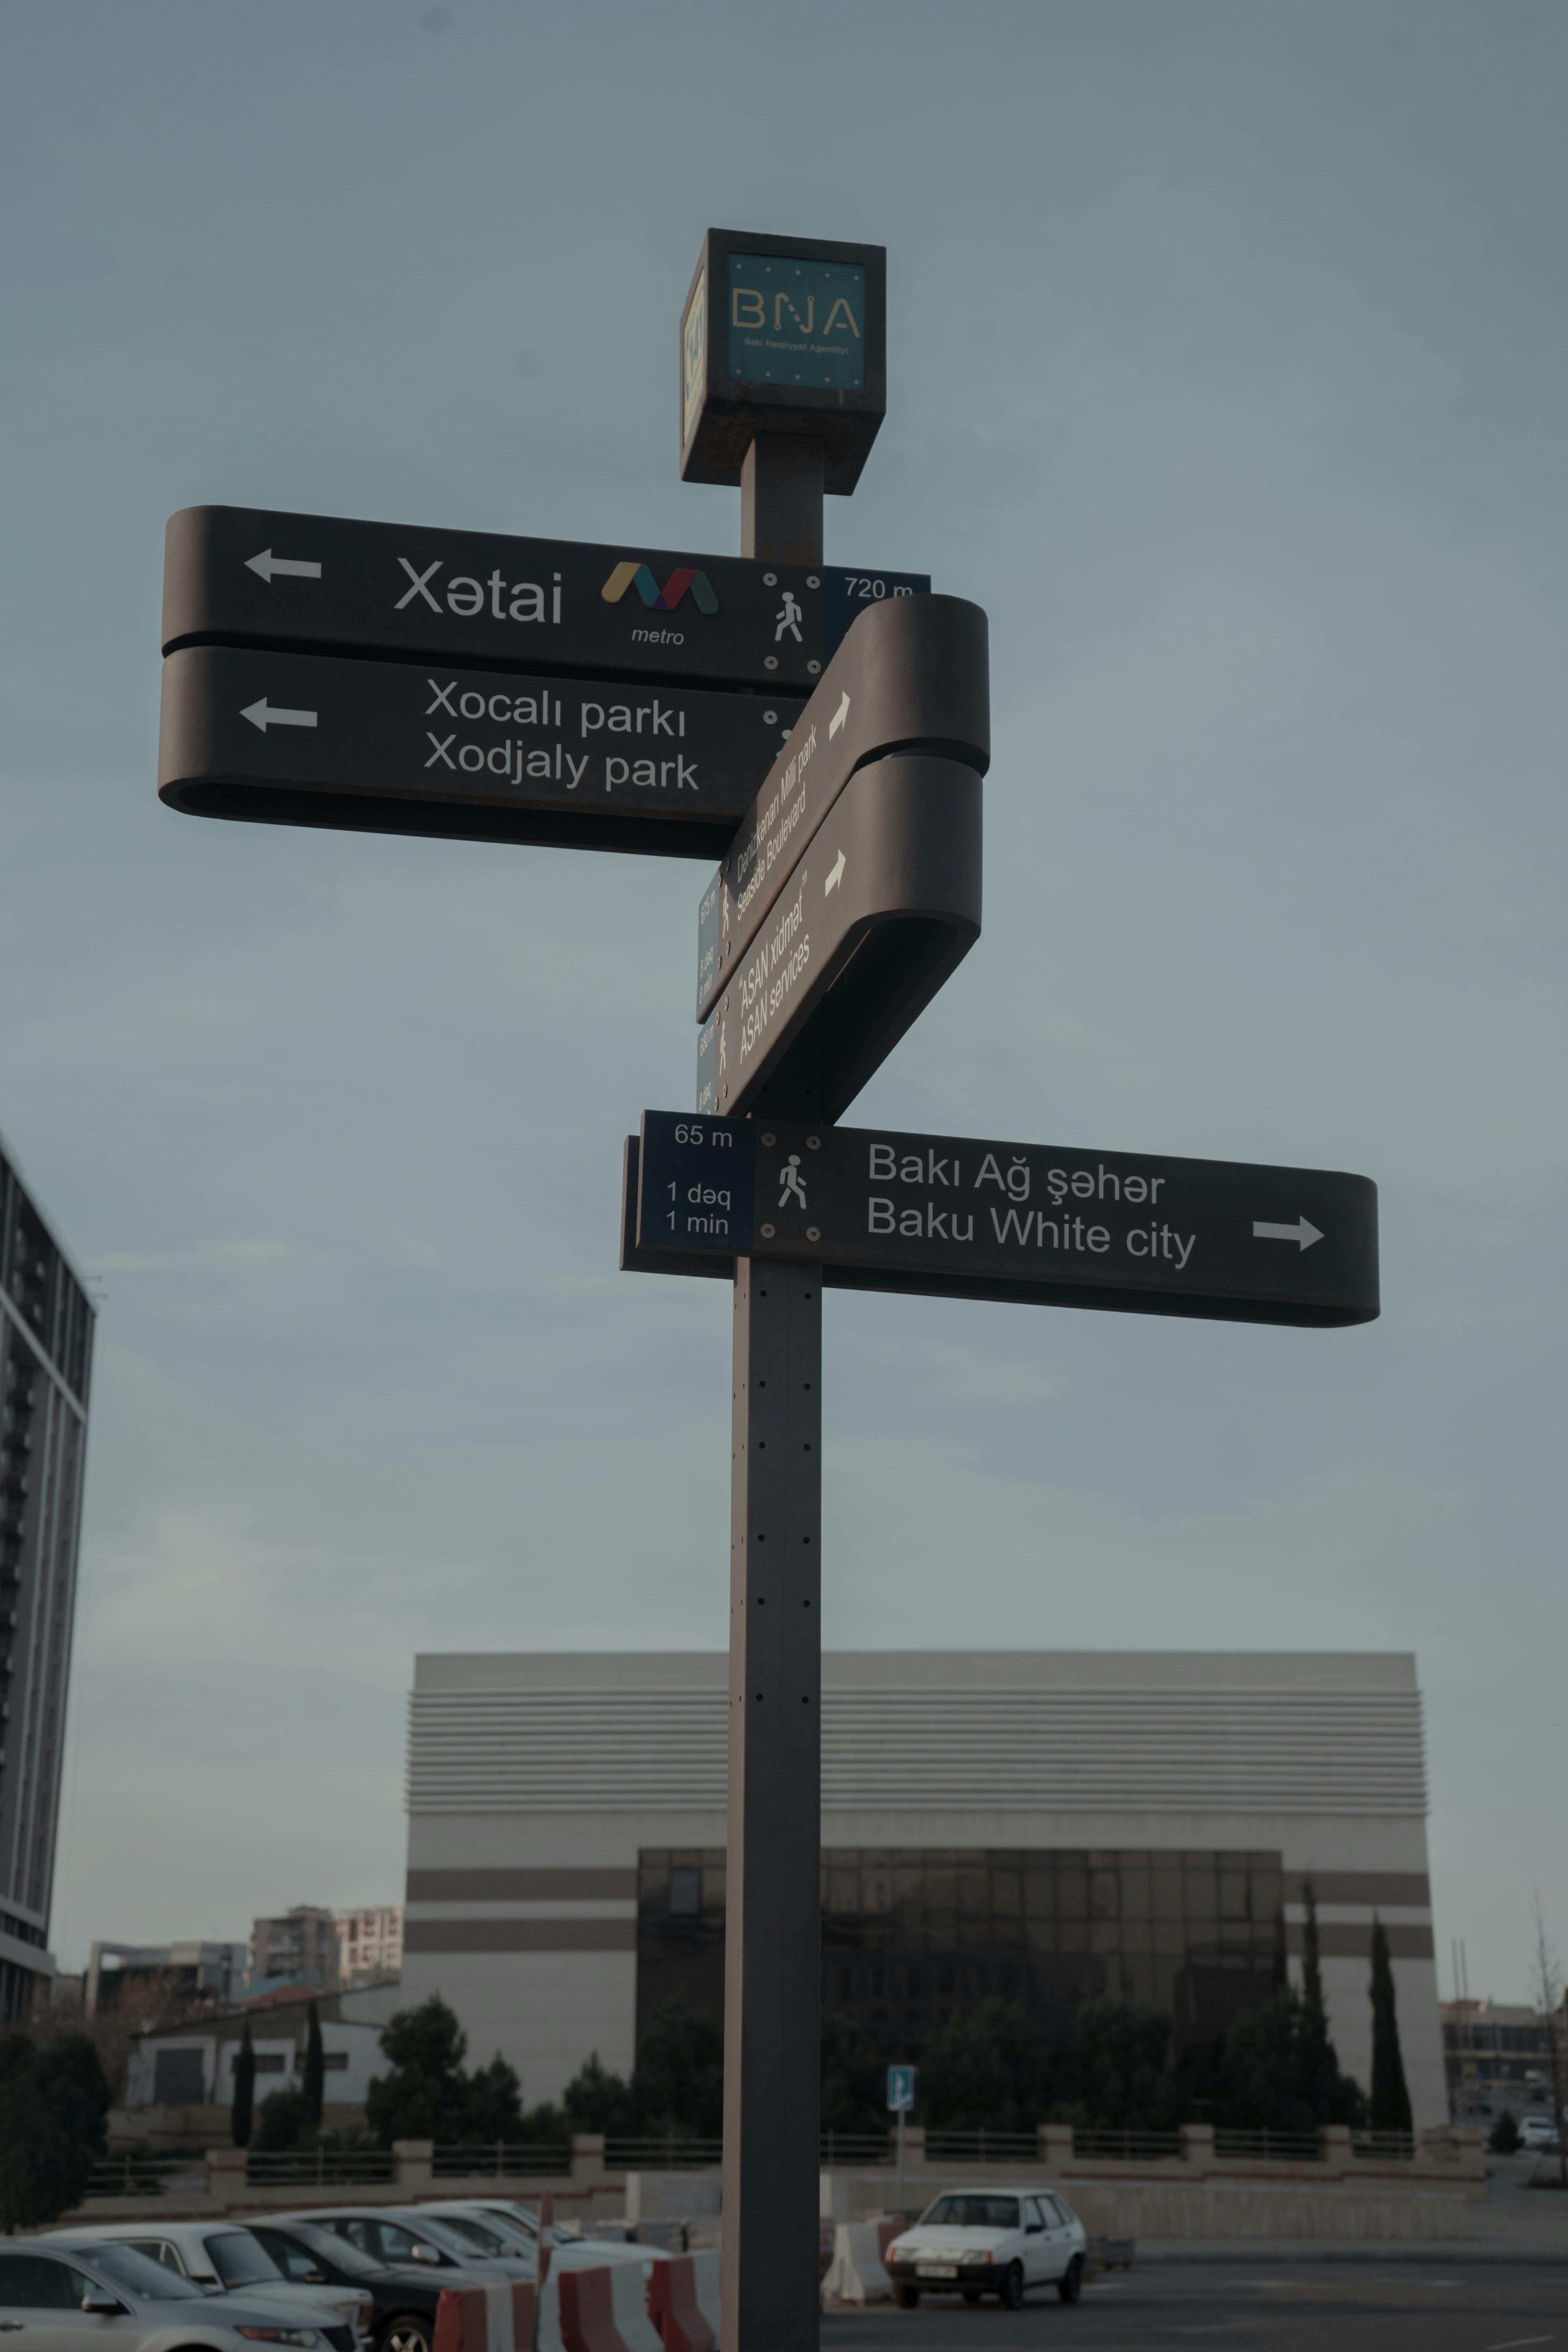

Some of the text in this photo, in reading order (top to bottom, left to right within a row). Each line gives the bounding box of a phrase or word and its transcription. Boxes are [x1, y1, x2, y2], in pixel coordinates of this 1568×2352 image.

[732, 288, 860, 338] BNA
[744, 337, 763, 346] Bakı
[809, 344, 849, 355] Agentliyi
[393, 557, 562, 624] Xətai
[844, 577, 886, 599] 720
[632, 629, 684, 646] metro
[425, 679, 685, 738] Xocalı parkı
[423, 732, 699, 792] Xodjaly park
[738, 724, 817, 884] Dənizkənarı Milli park
[737, 780, 805, 921] Seaside Boulevard
[701, 890, 715, 925] 675 m
[700, 946, 713, 978] 8 dəq
[699, 973, 712, 1004] 8 min
[740, 933, 809, 1065] ASAN services
[700, 1024, 714, 1057] 680 m
[699, 1092, 702, 1112] 8
[703, 1081, 711, 1105] dəq
[675, 1124, 732, 1148] 65 m
[869, 1143, 1166, 1205] Bakı Ağ şəhər
[667, 1181, 731, 1211] 1 dəq
[666, 1210, 728, 1235] 1 min
[868, 1197, 1196, 1270] Baku White city
